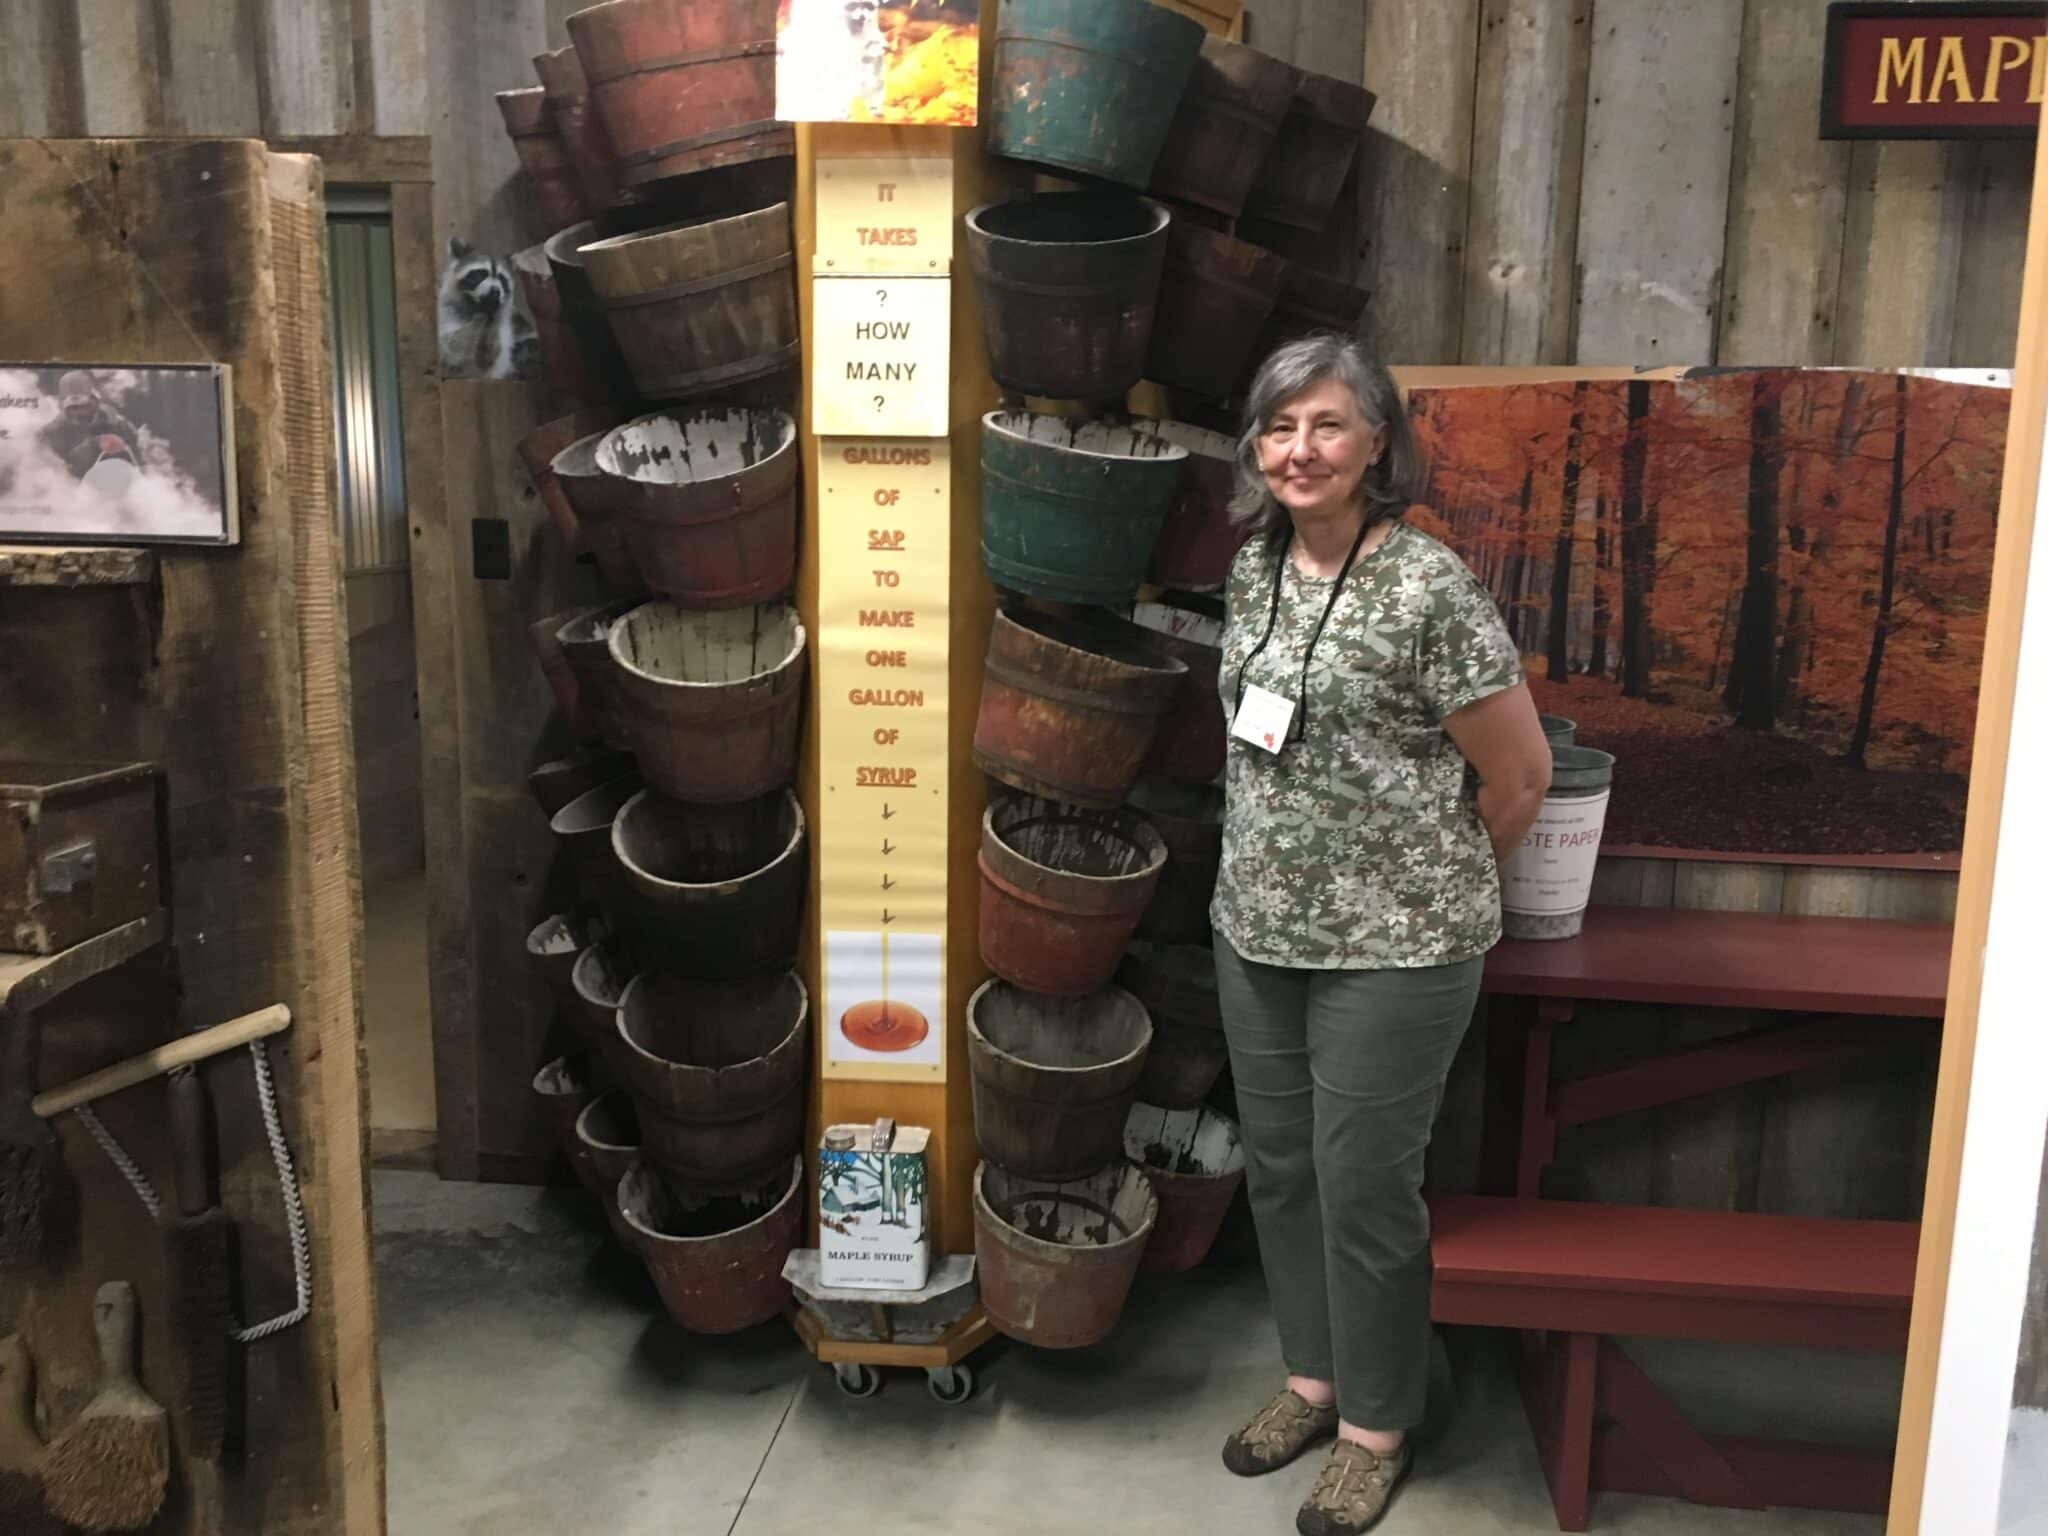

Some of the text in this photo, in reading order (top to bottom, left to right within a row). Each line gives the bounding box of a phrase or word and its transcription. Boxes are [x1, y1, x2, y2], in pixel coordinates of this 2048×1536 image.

[877, 183, 896, 202] IT
[856, 227, 918, 246] TAKES
[876, 289, 888, 307] ?
[856, 321, 911, 340] HOW
[845, 362, 917, 381] MANY
[873, 395, 885, 412] ?
[842, 447, 932, 466] GALLONS
[873, 488, 900, 507] OF
[867, 529, 906, 549] SAP
[872, 570, 900, 588] TO
[858, 610, 915, 628] MAKE
[865, 650, 907, 668] ONE
[848, 688, 924, 707] GALLON
[873, 728, 900, 746] OF
[855, 766, 917, 787] SYRUP
[1520, 832, 1554, 848] STE
[828, 1251, 914, 1262] MAPLE SYRUP
